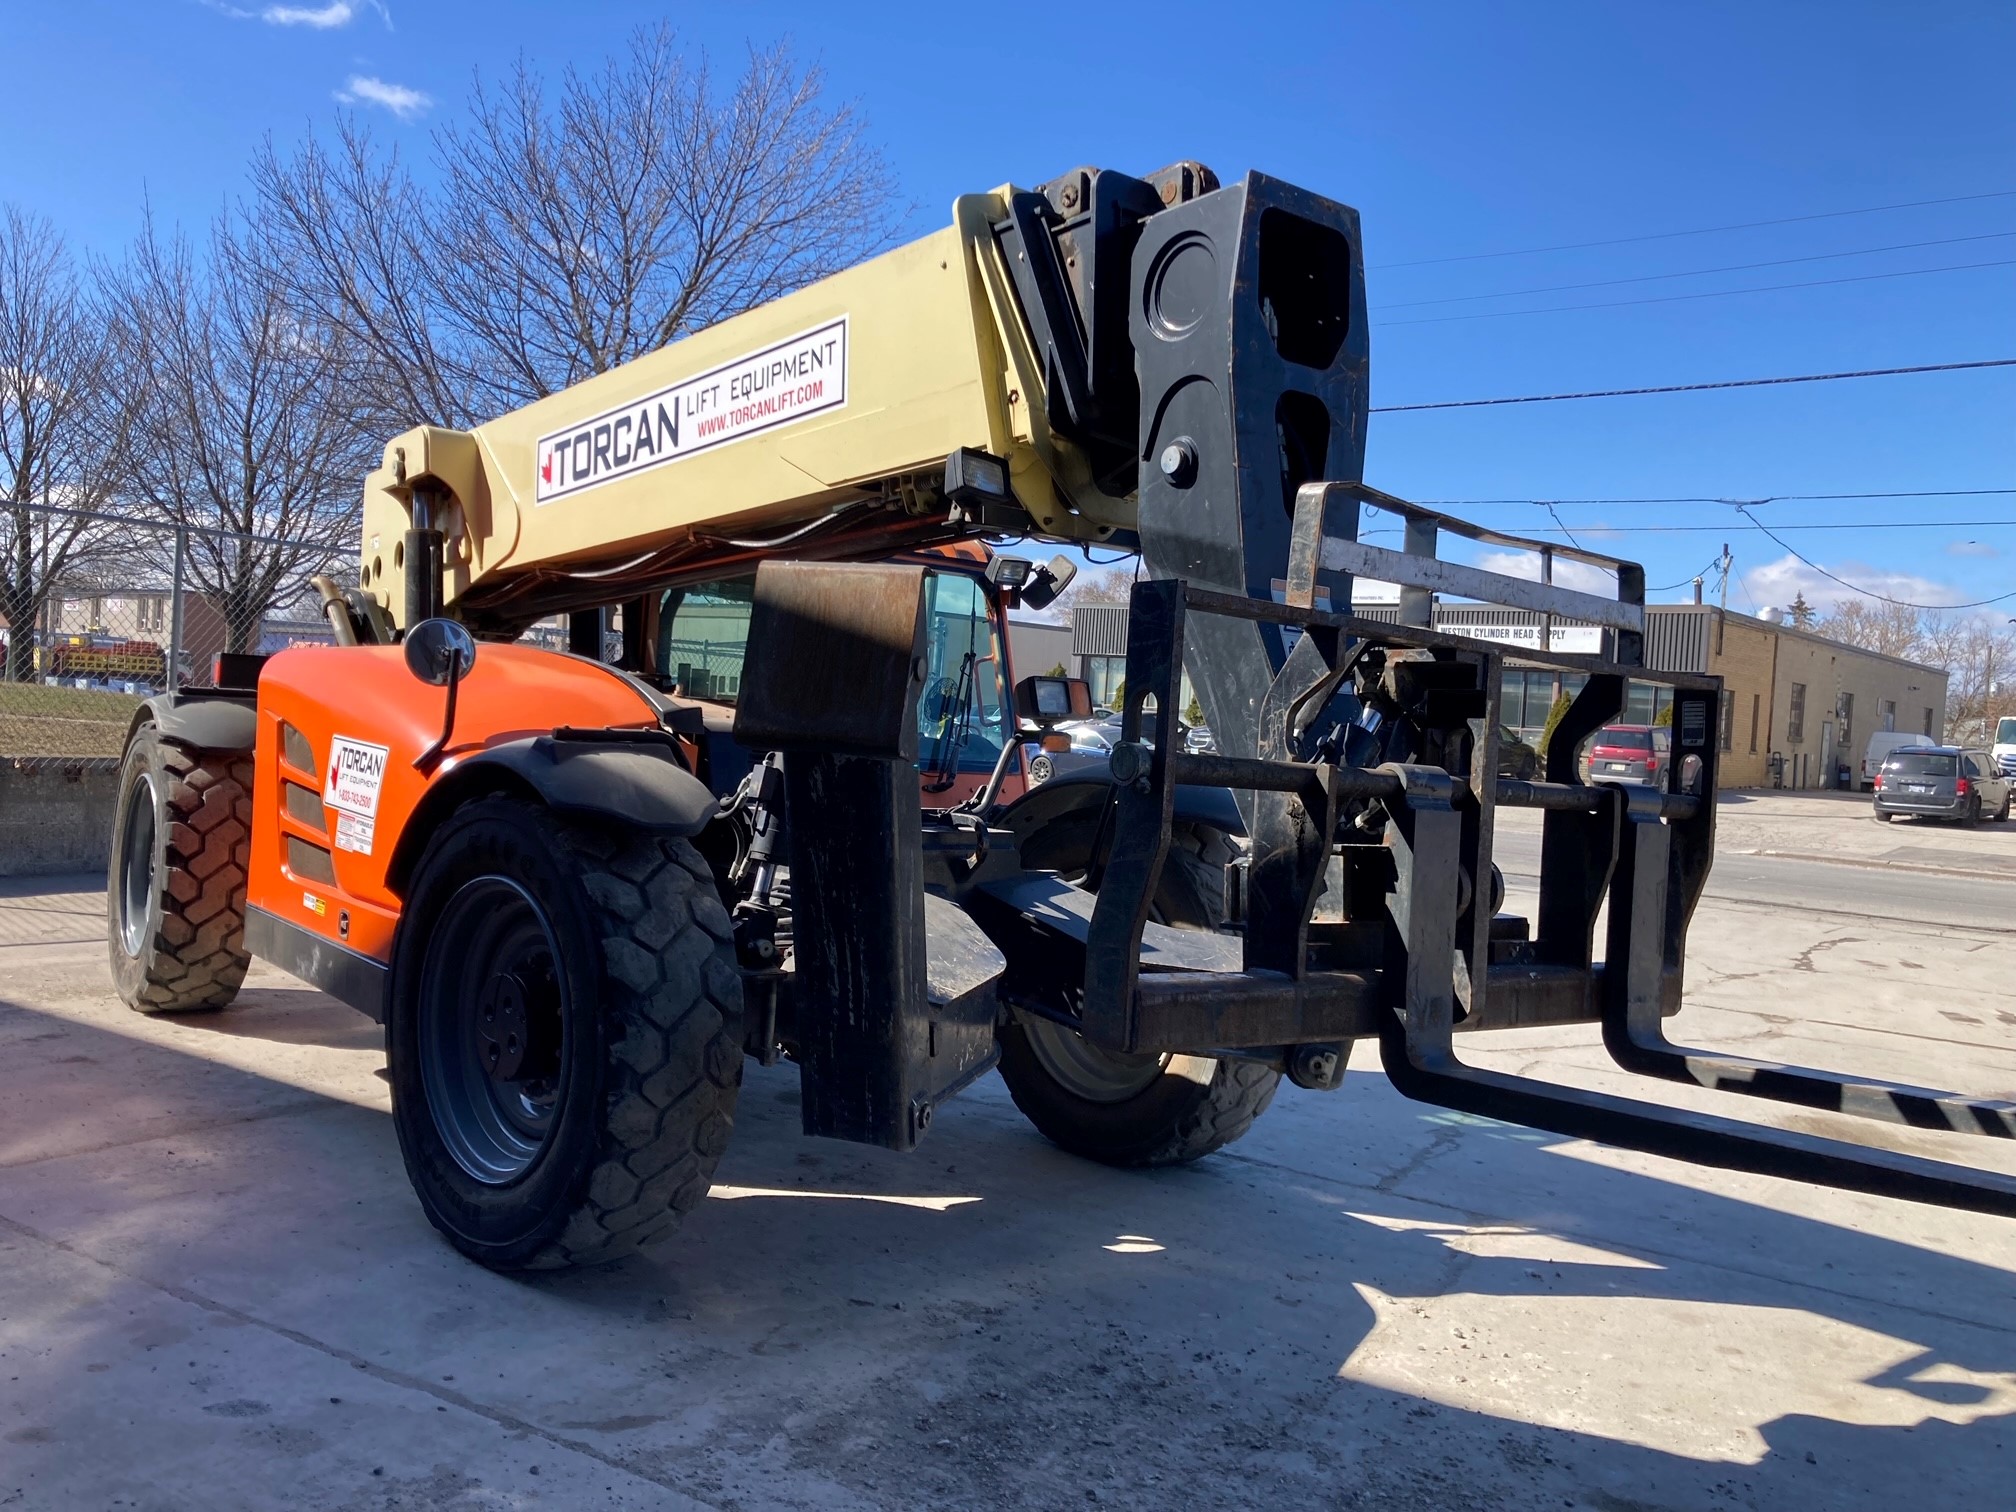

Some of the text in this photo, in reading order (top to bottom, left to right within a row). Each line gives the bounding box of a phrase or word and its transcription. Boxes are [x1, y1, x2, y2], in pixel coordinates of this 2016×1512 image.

[554, 339, 837, 487] TORCAN LIFT EQUIPMENT
[698, 379, 823, 438] WWW.TORCANLIFT.COM
[1440, 626, 1566, 640] WESTON CYLINDER HEAD SPPLY
[341, 746, 384, 778] TORCAN
[339, 772, 378, 790] LIFT EQUIPMENT
